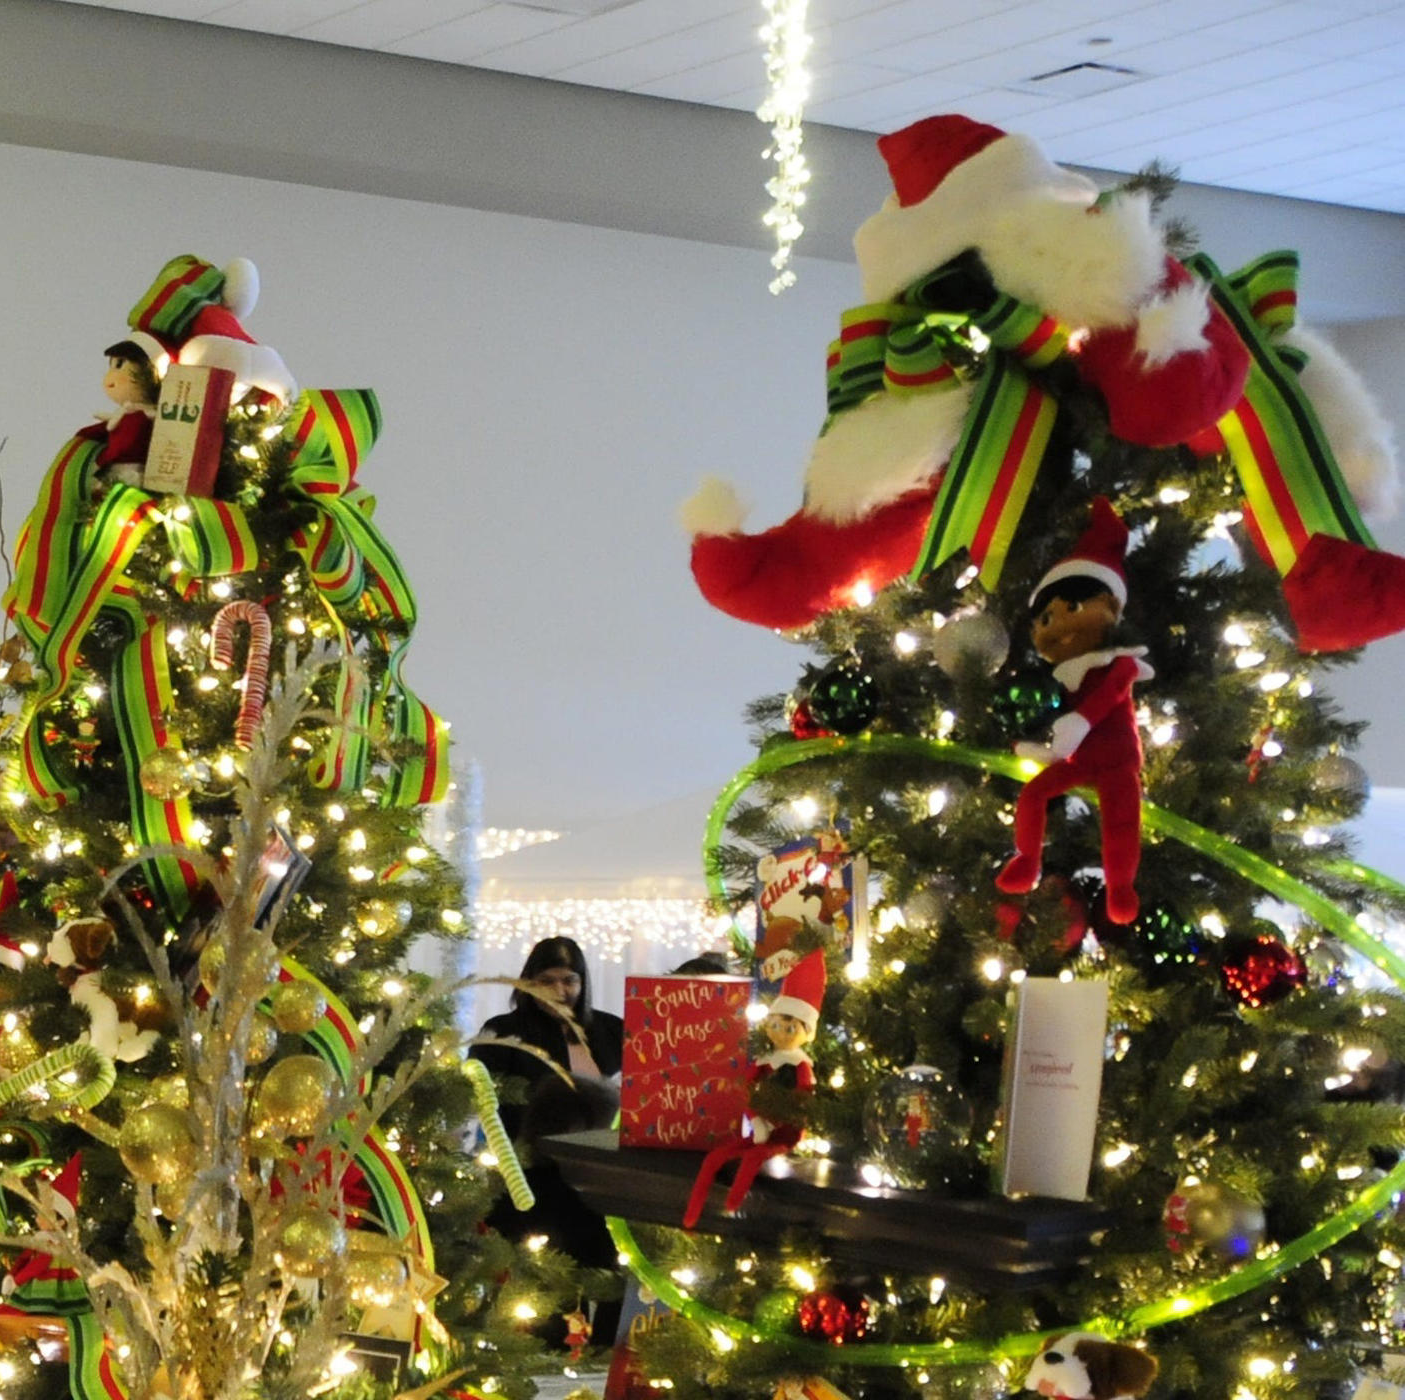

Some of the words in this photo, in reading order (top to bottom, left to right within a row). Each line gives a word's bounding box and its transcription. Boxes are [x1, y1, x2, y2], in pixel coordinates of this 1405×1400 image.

[654, 982, 712, 1017] Santa
[652, 1017, 713, 1060] please
[658, 1083, 697, 1114] stop
[657, 1114, 698, 1145] here
